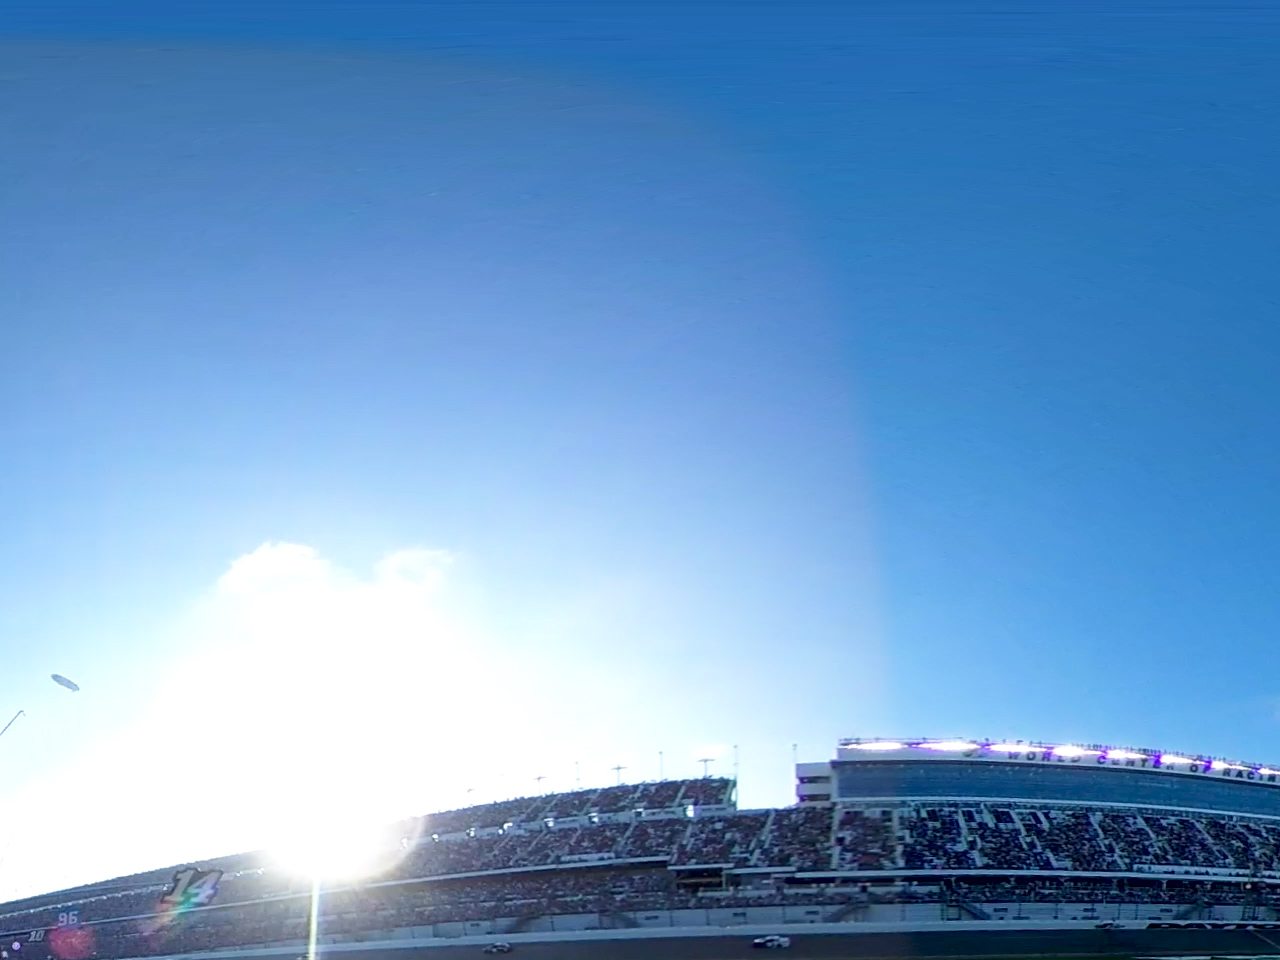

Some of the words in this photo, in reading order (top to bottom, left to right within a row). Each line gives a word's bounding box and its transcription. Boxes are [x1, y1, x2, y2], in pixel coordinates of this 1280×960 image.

[164, 869, 222, 904] 14
[58, 911, 79, 926] 96
[28, 930, 45, 942] 10
